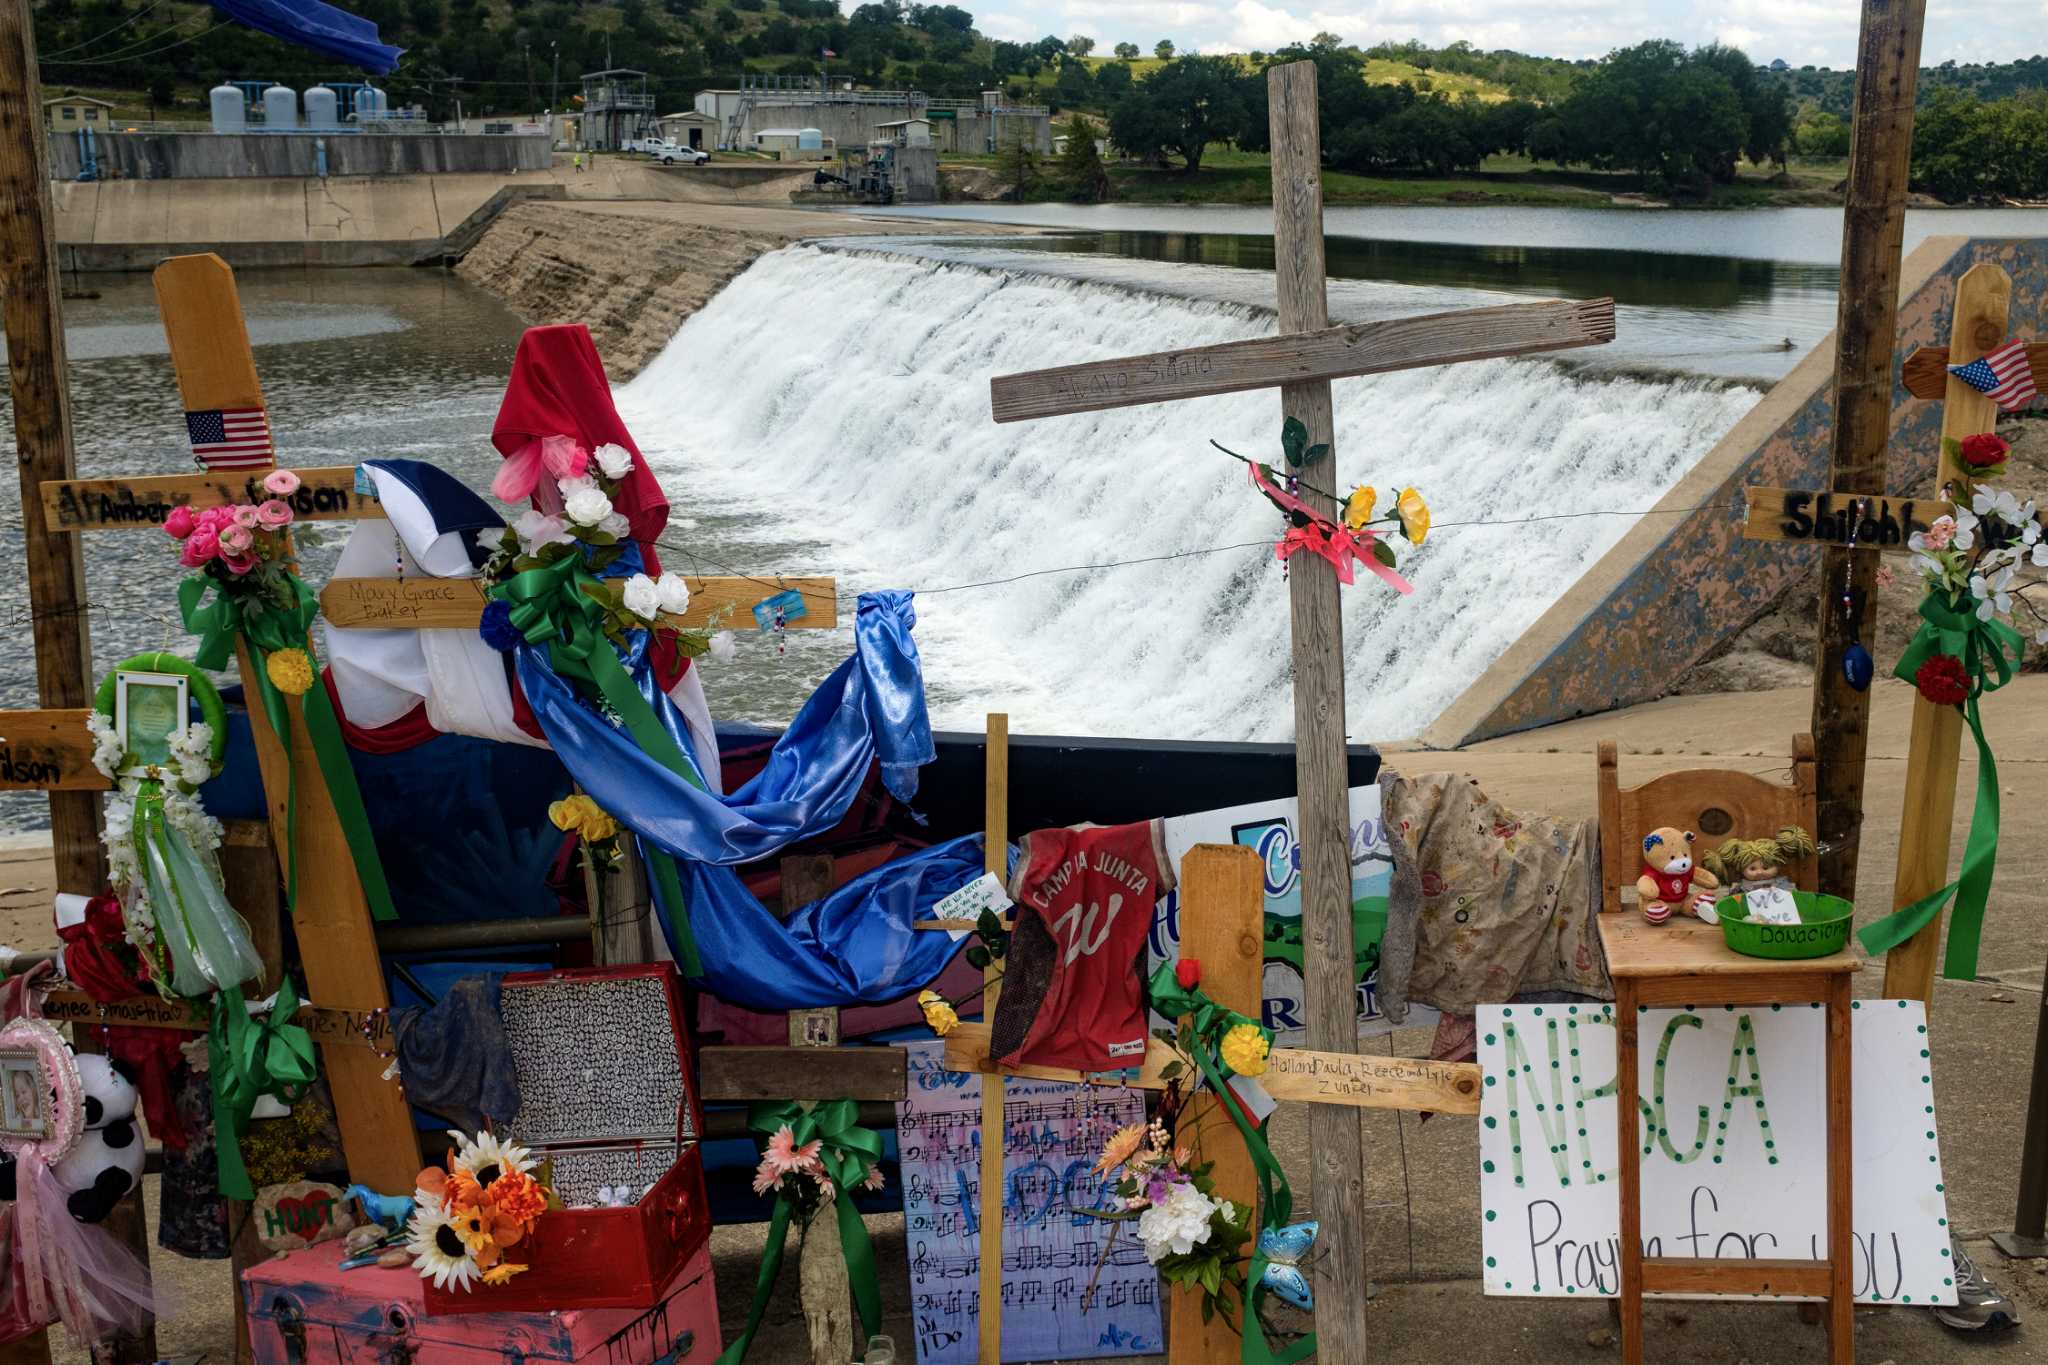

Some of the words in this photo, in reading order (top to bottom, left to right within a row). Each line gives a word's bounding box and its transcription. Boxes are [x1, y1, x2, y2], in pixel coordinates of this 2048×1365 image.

[350, 582, 396, 607] Mary
[0, 746, 61, 784] ilson
[1032, 860, 1073, 908] CAMP
[1093, 851, 1150, 897] JUNTA
[1503, 1013, 1781, 1189] NBCA
[1526, 1200, 1663, 1296] Prayi
